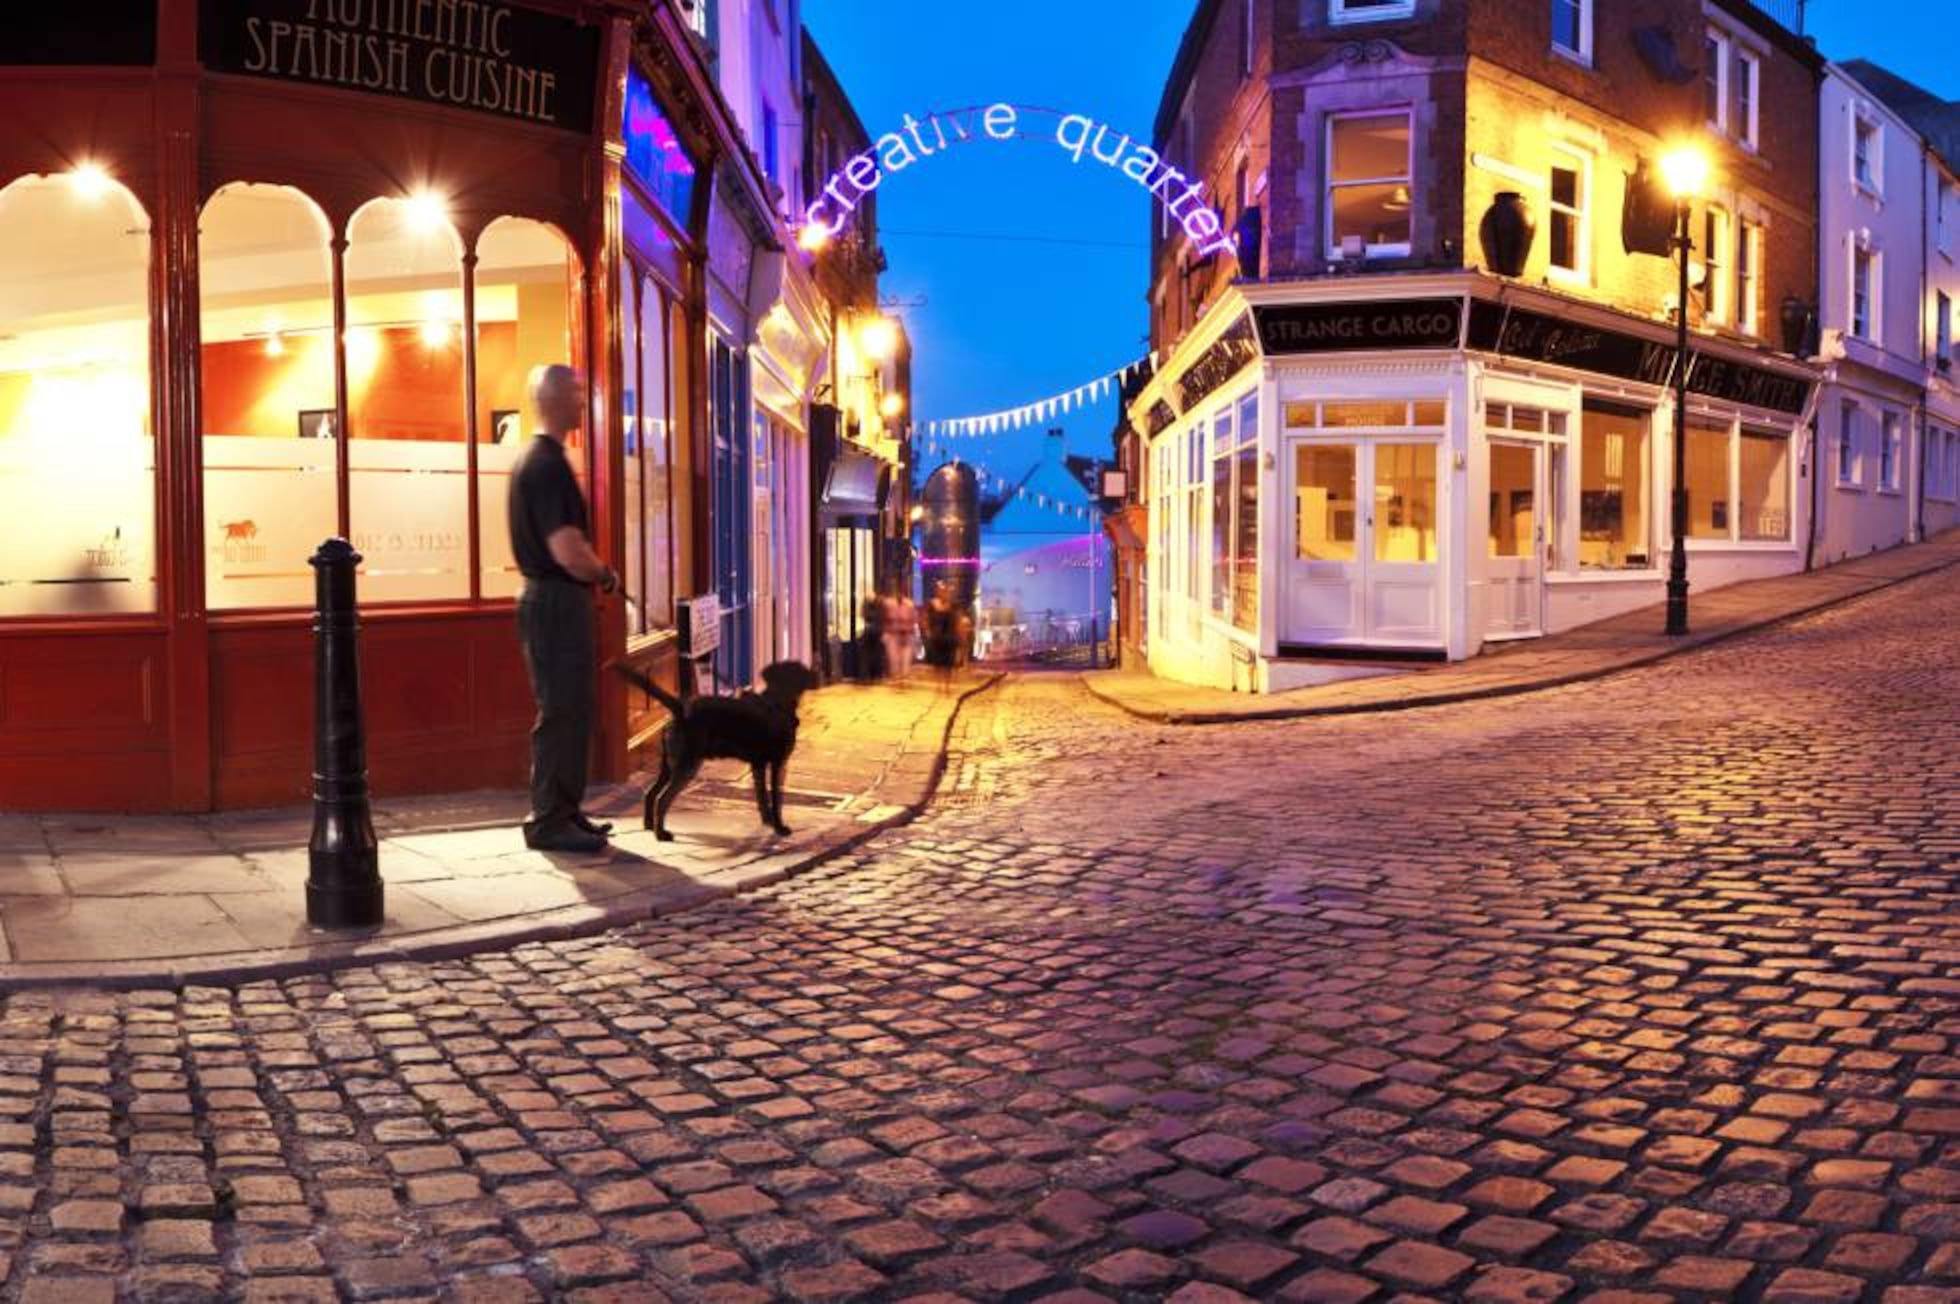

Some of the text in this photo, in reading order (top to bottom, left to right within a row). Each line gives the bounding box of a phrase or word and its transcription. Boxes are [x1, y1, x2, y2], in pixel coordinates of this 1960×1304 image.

[243, 16, 556, 121] SPANISH CUISINE
[805, 102, 1238, 257] creative quarter
[1266, 313, 1453, 341] STRANGE CARGO
